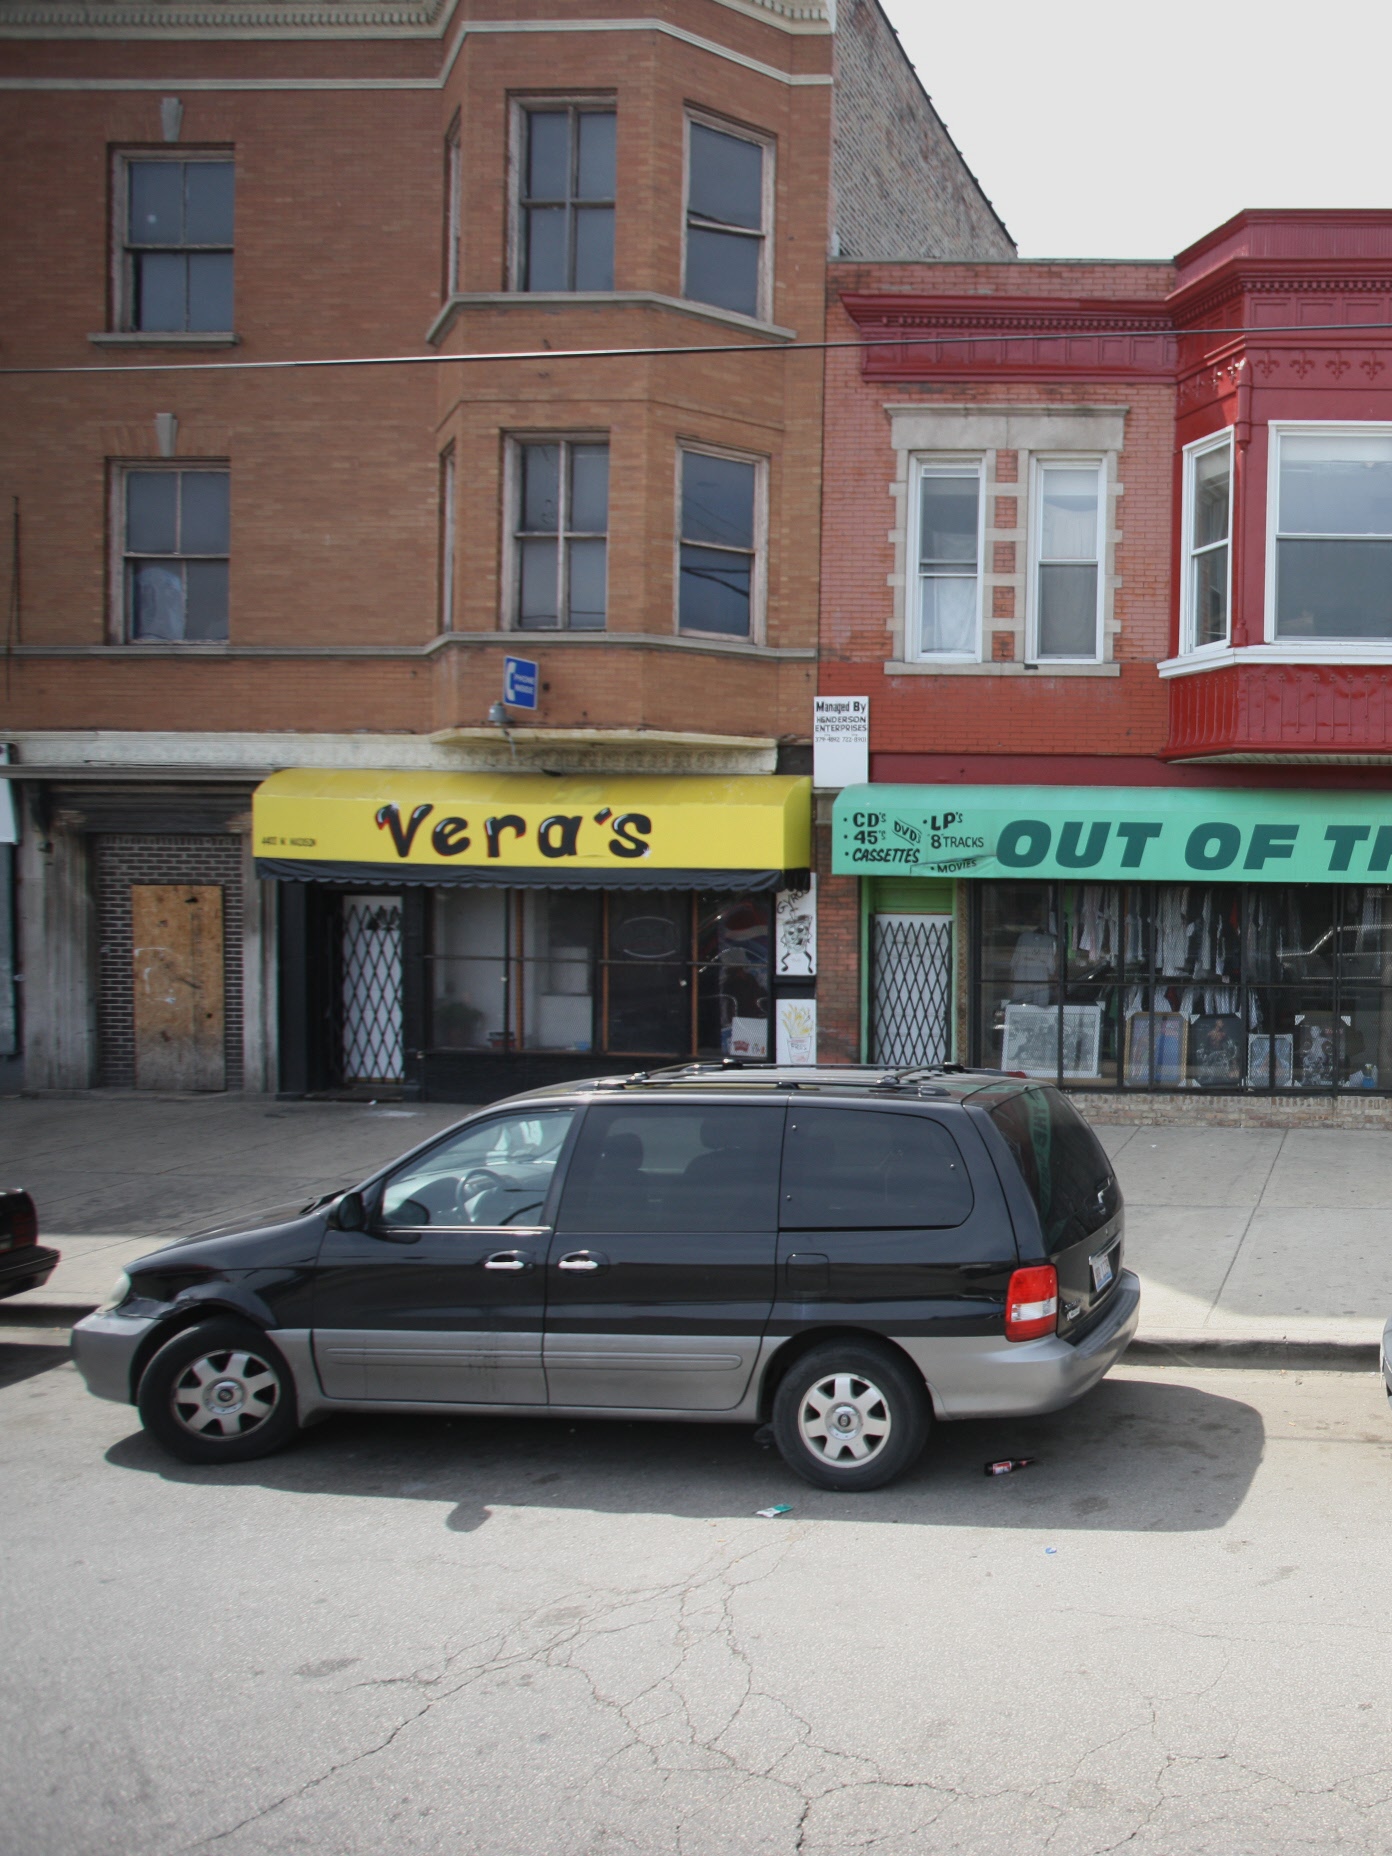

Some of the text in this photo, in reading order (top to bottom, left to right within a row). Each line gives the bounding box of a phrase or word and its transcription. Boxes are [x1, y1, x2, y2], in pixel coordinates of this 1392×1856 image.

[816, 701, 866, 714] Managed By
[375, 802, 652, 858] Vera's
[943, 836, 984, 848] TRACKS
[996, 819, 1163, 868] OUT
[1184, 821, 1299, 870] OF
[852, 848, 920, 863] CASSETTES
[937, 859, 977, 873] MOVIES
